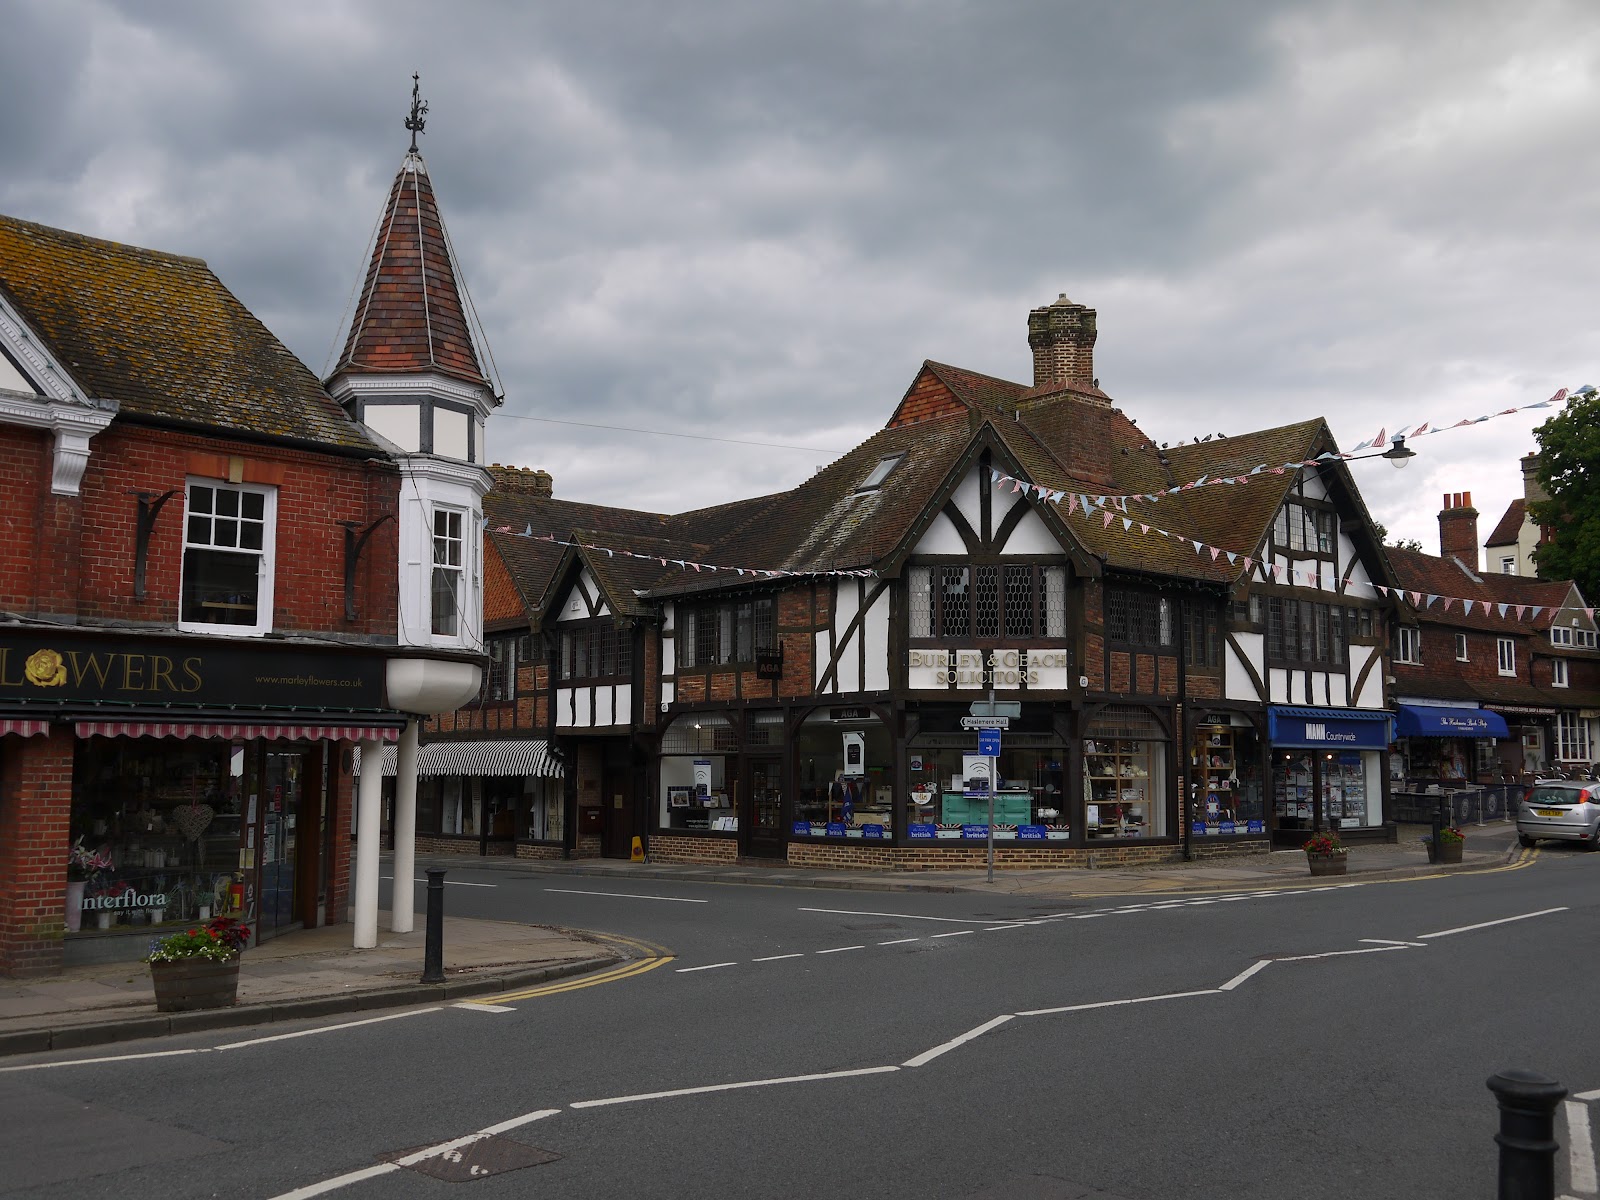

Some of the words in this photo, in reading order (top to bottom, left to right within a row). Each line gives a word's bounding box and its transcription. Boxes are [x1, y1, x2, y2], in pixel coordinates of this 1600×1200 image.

[908, 650, 983, 667] BURLEY
[986, 652, 999, 667] &
[1003, 651, 1067, 668] GEACH
[759, 663, 780, 673] AGA
[255, 675, 363, 688] www.marleyflowers.co.uk
[936, 670, 1039, 684] SOLICITORS
[840, 709, 859, 718] AGA
[1207, 715, 1222, 724] AGA
[1305, 723, 1326, 740] MANN
[1326, 731, 1356, 743] Countrywide
[113, 908, 124, 916] say
[145, 906, 167, 914] flowers
